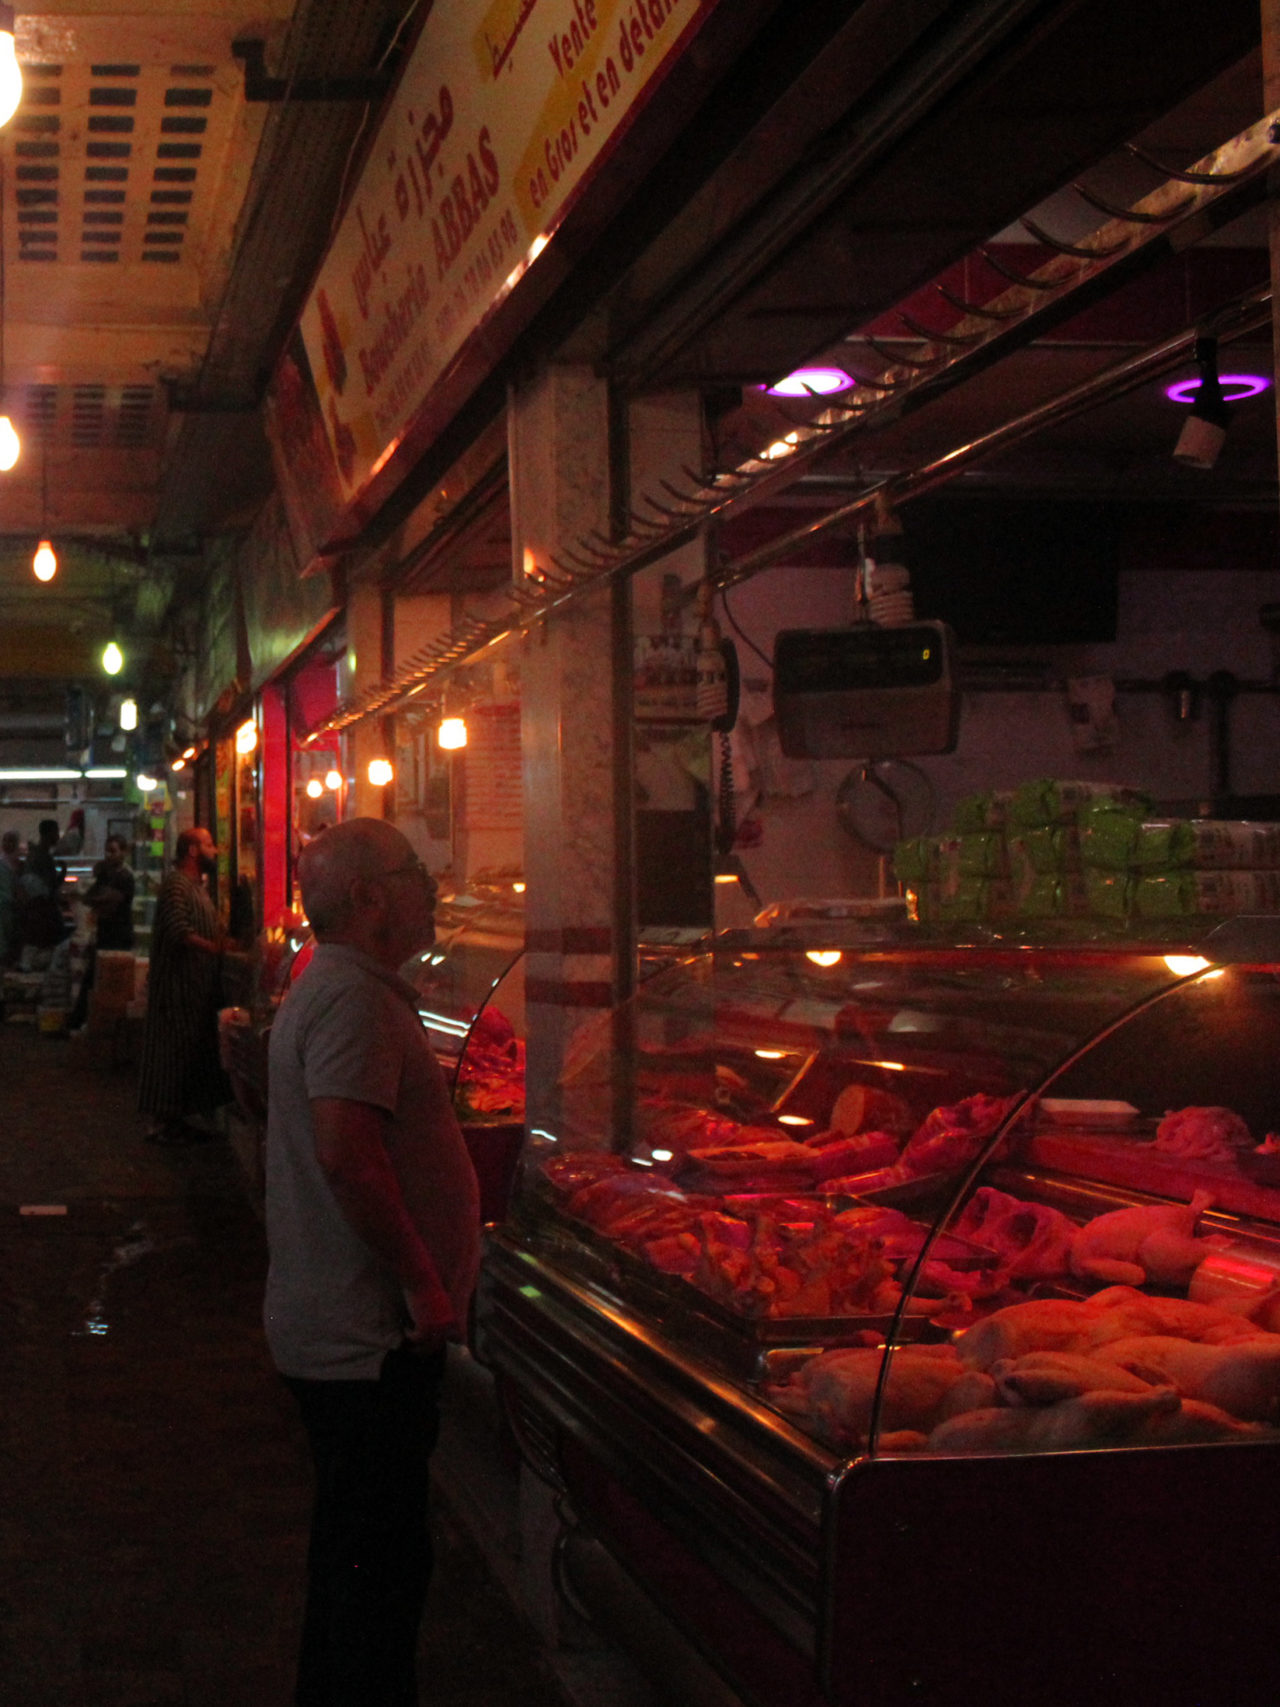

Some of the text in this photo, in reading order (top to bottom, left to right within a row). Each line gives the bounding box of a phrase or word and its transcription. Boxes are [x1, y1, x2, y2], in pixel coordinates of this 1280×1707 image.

[352, 84, 454, 321] مجزرة عباس
[432, 125, 500, 282] ABBAS
[528, 167, 549, 208] en
[578, 81, 598, 135] et
[595, 57, 621, 108] en
[619, 0, 677, 72] déta
